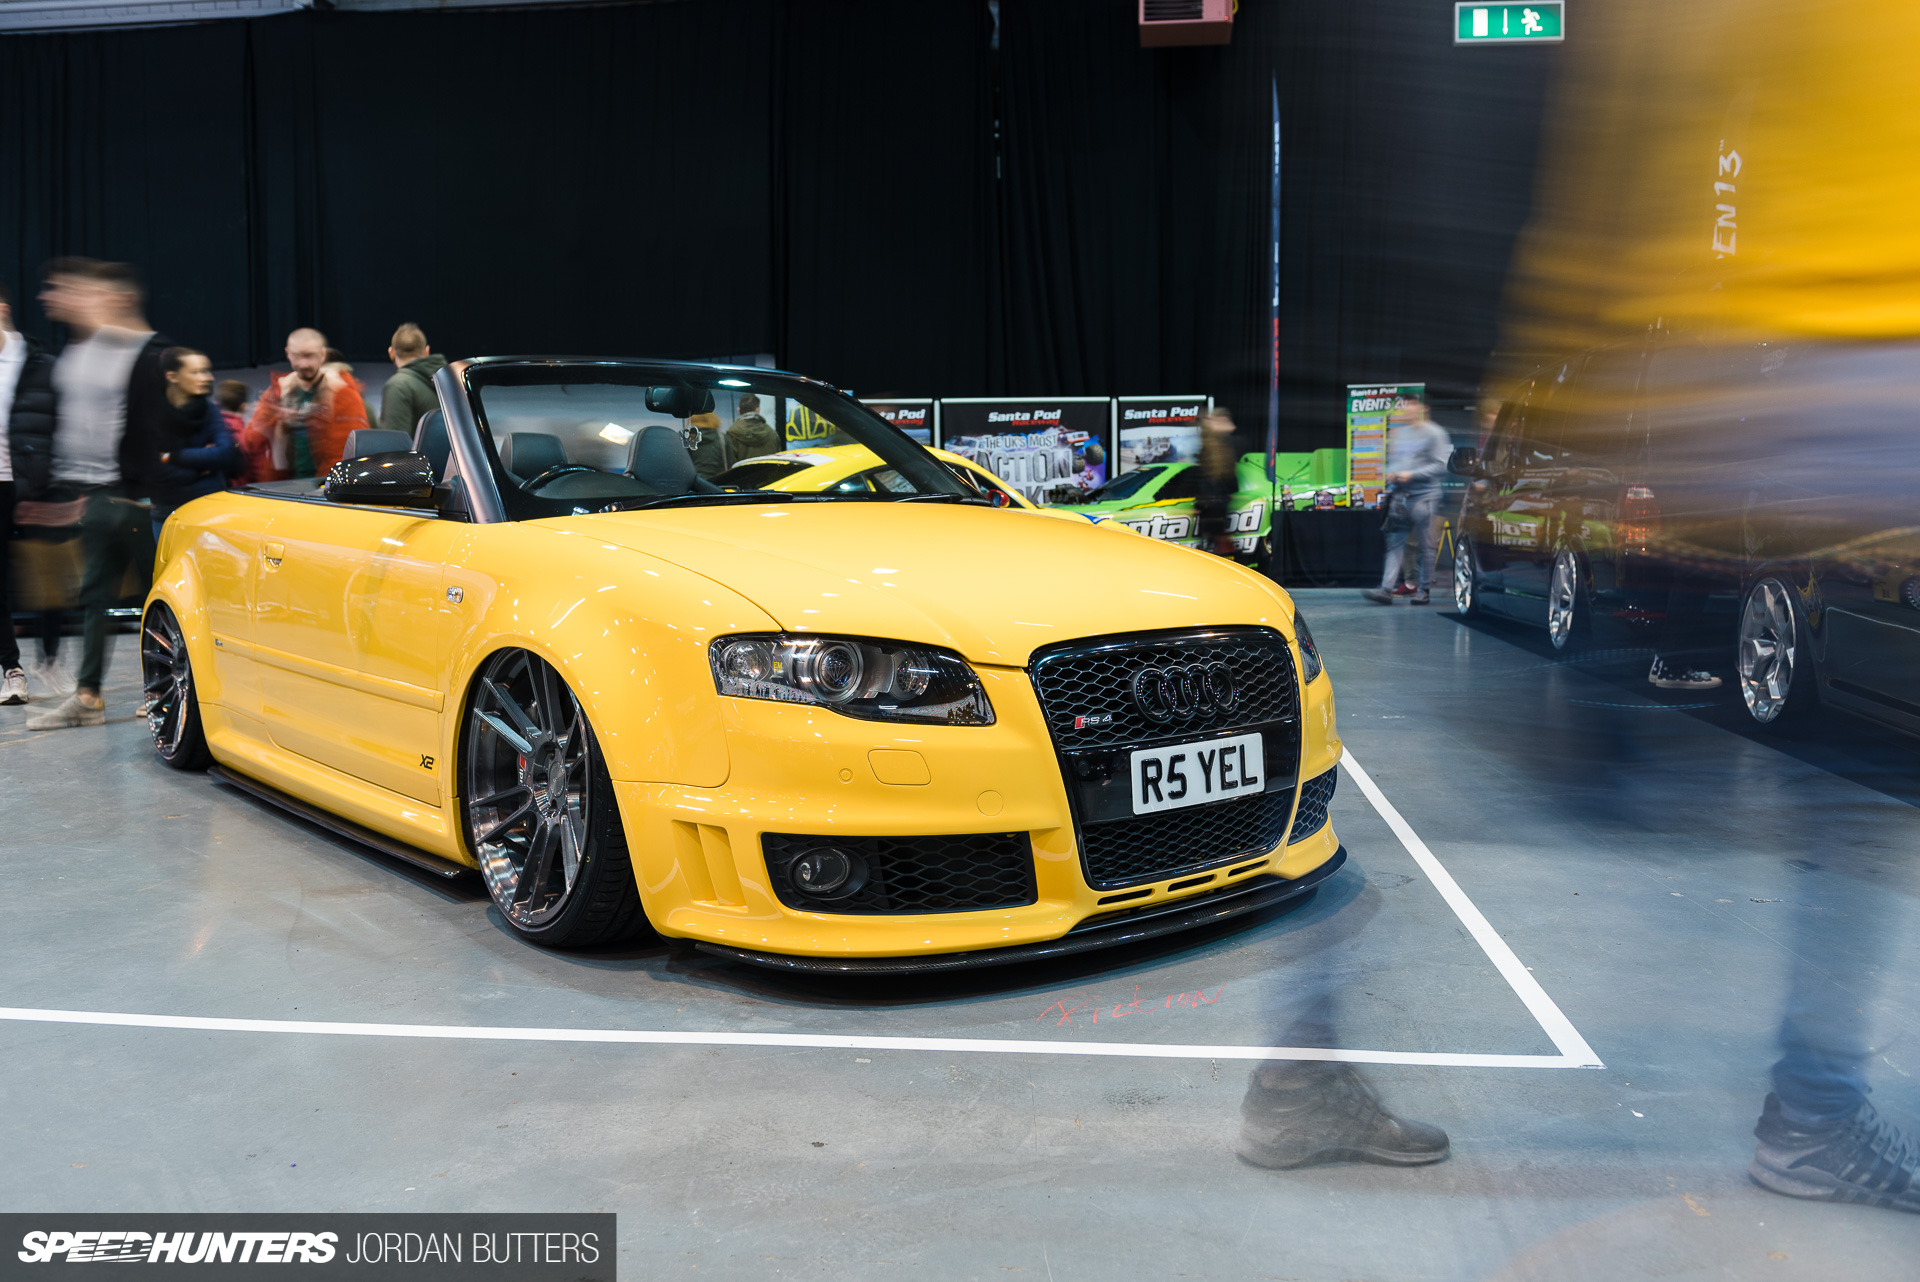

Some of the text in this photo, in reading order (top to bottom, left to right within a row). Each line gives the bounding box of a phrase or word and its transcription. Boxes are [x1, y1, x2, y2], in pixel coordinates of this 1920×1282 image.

[1351, 397, 1392, 412] EVENTS
[898, 409, 926, 419] Pod
[988, 409, 1061, 422] Santa Pod
[1124, 405, 1199, 420] Santa Pod
[985, 434, 1058, 449] THE UK'S MOST
[975, 449, 1071, 483] ACTION
[1114, 514, 1190, 540] nta
[419, 753, 434, 770] X2
[1141, 744, 1258, 805] R5 YEL
